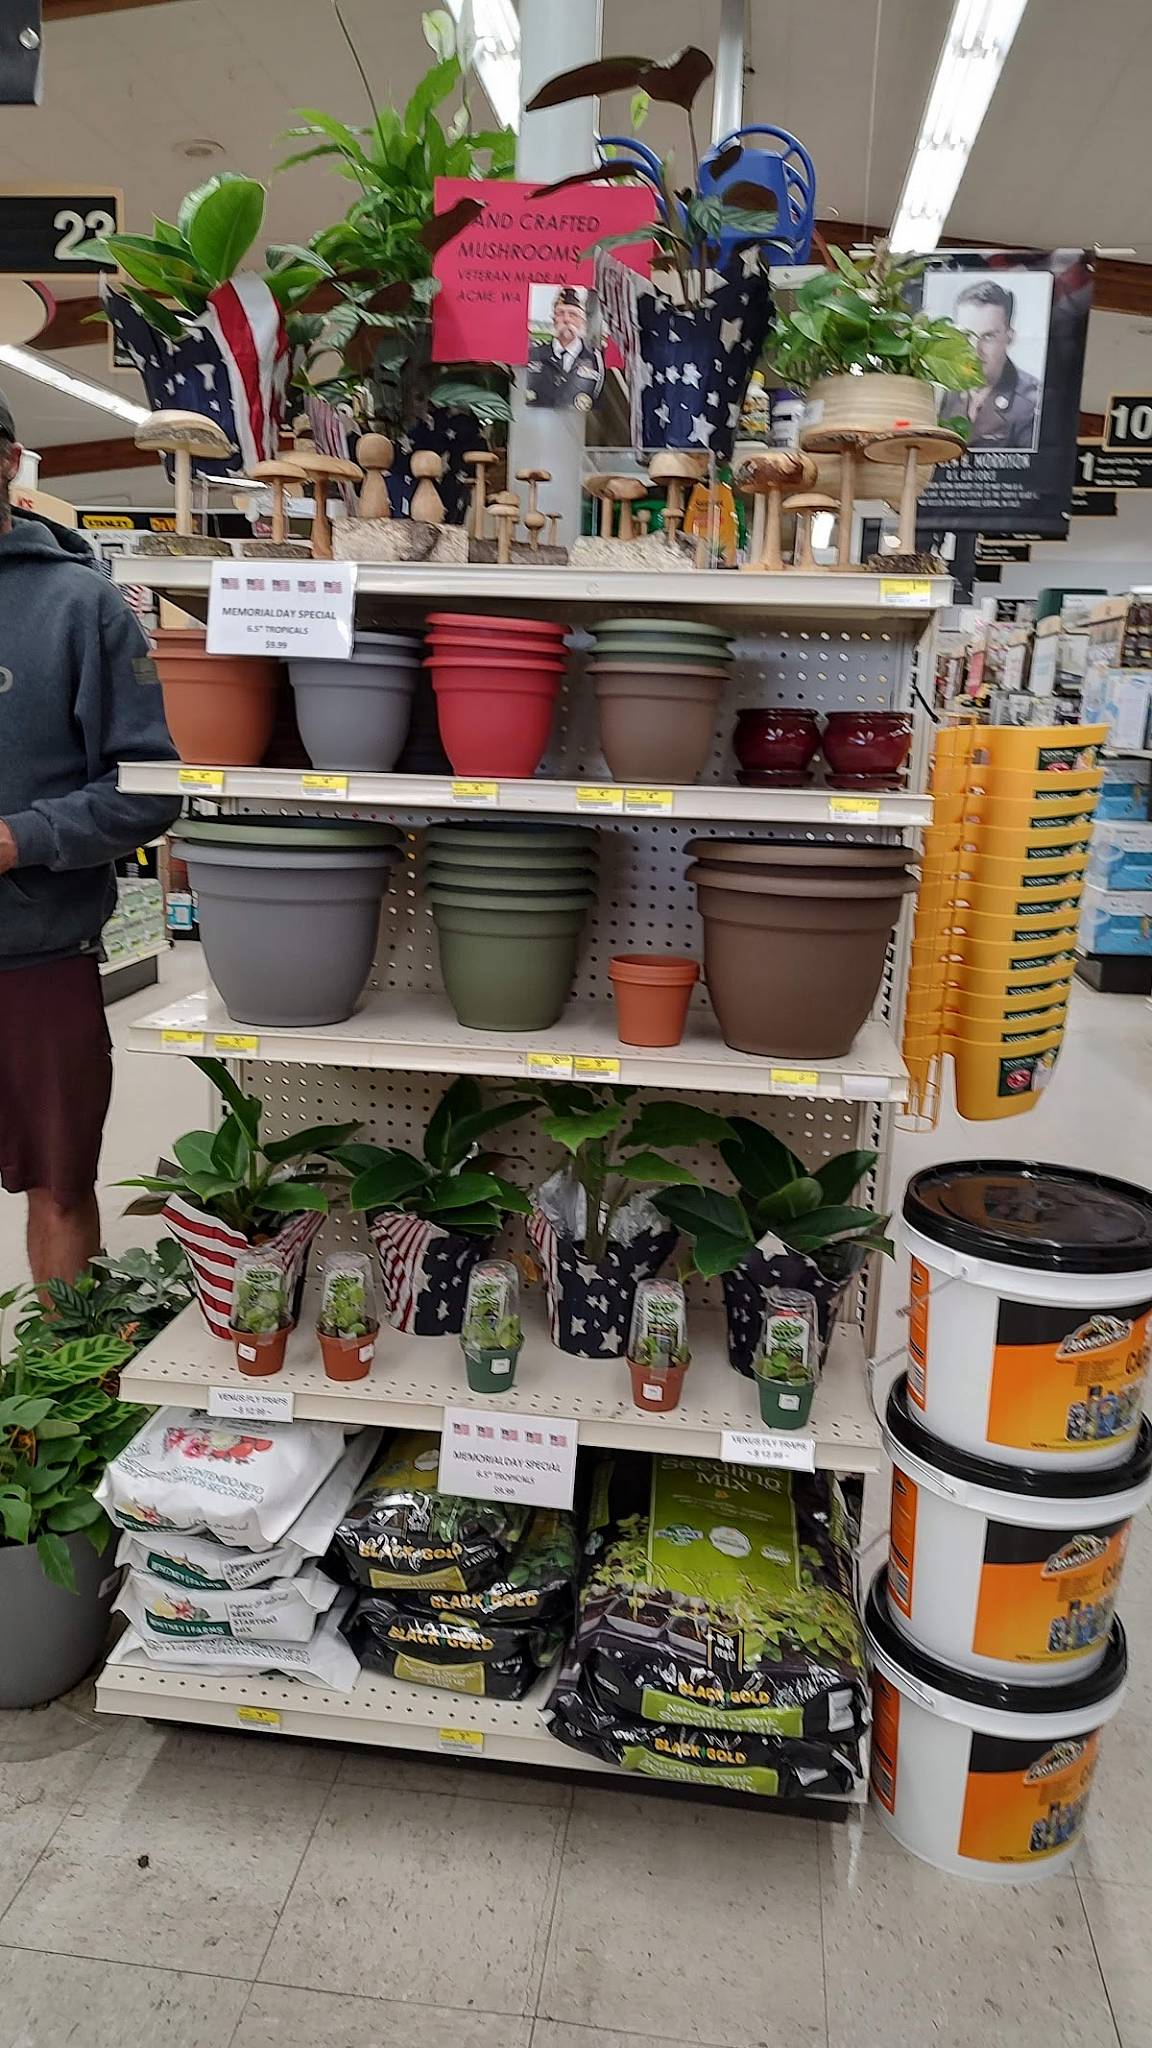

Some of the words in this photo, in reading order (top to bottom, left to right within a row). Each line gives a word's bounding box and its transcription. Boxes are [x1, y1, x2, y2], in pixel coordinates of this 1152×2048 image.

[472, 212, 513, 232] AND
[519, 213, 600, 234] CRAFTED
[457, 241, 582, 263] MUSHROOMS
[457, 270, 511, 283] VETERAN
[514, 272, 551, 284] MADE
[554, 273, 568, 285] IN
[457, 291, 496, 303] ACME
[500, 291, 522, 303] WA
[1110, 404, 1152, 440] 10
[298, 609, 337, 620] SPECIAL
[265, 625, 309, 636] TROPICALS
[696, 1471, 751, 1493] Mix
[678, 1681, 725, 1702] BLACK
[730, 1689, 770, 1705] GOLD
[654, 1737, 701, 1758] BLACK
[705, 1747, 747, 1765] GOLD
